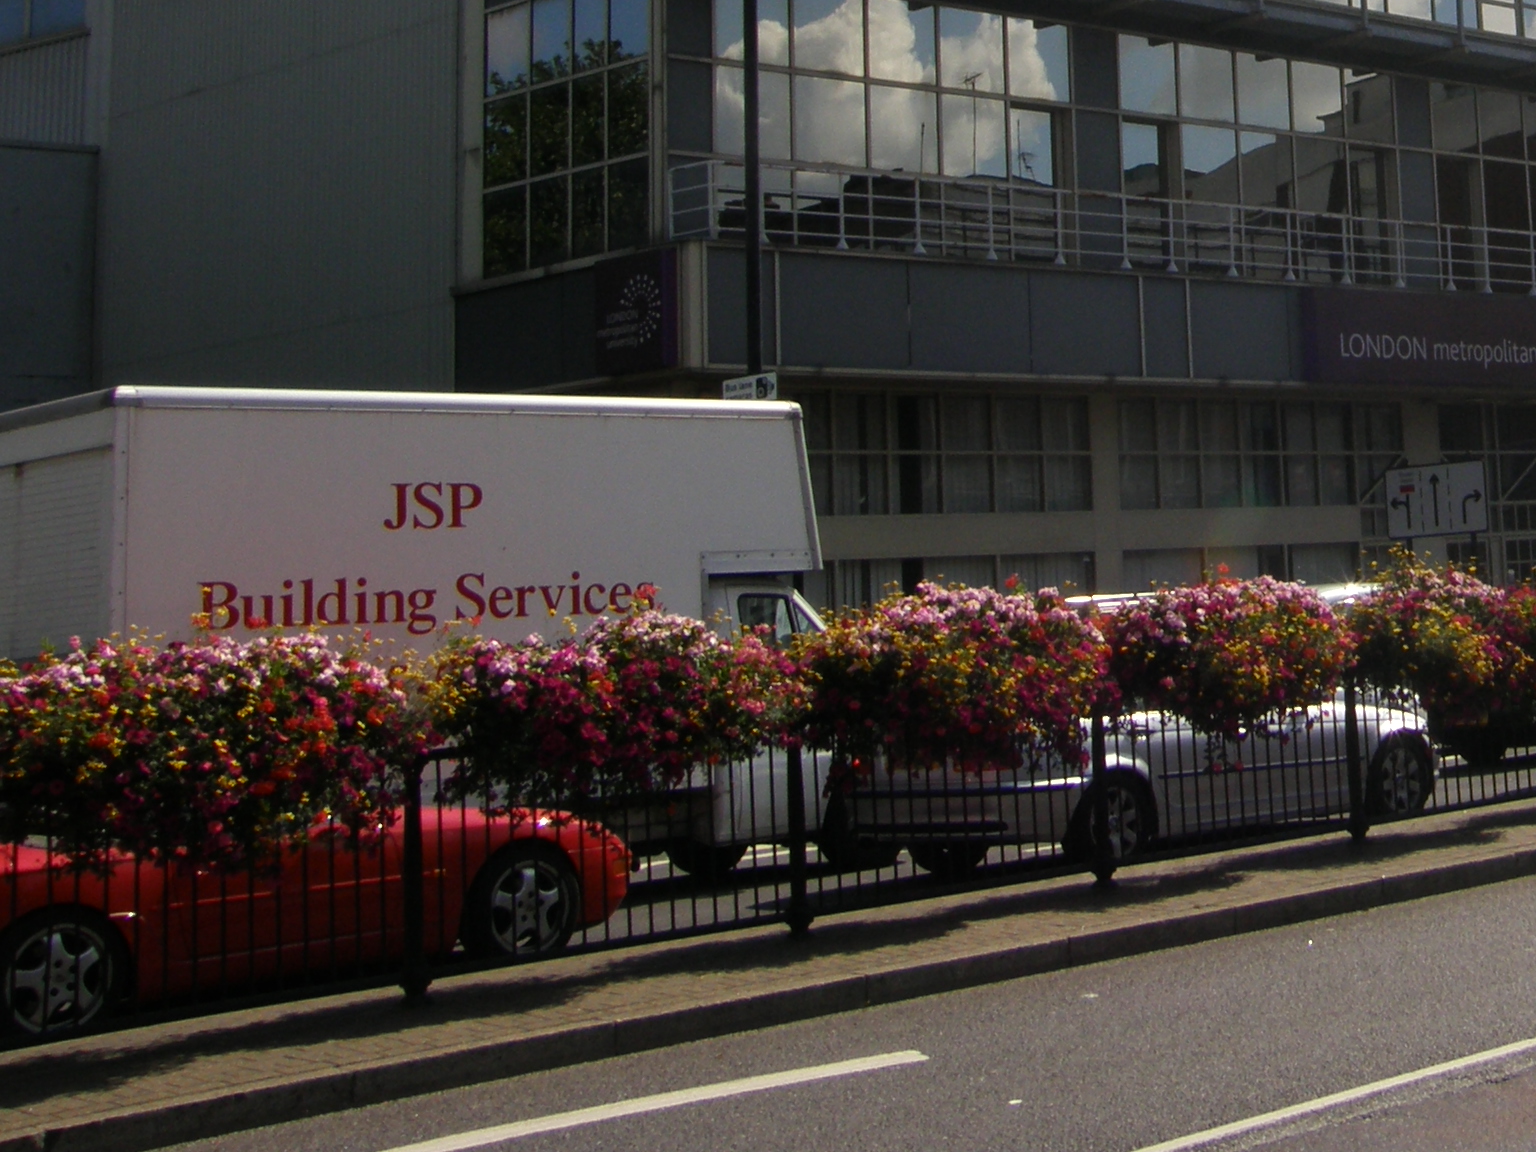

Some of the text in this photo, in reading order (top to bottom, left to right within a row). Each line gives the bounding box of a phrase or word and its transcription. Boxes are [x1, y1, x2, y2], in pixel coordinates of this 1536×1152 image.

[1340, 332, 1427, 360] LONDON
[383, 481, 483, 530] JSP
[200, 571, 655, 635] Building Services
